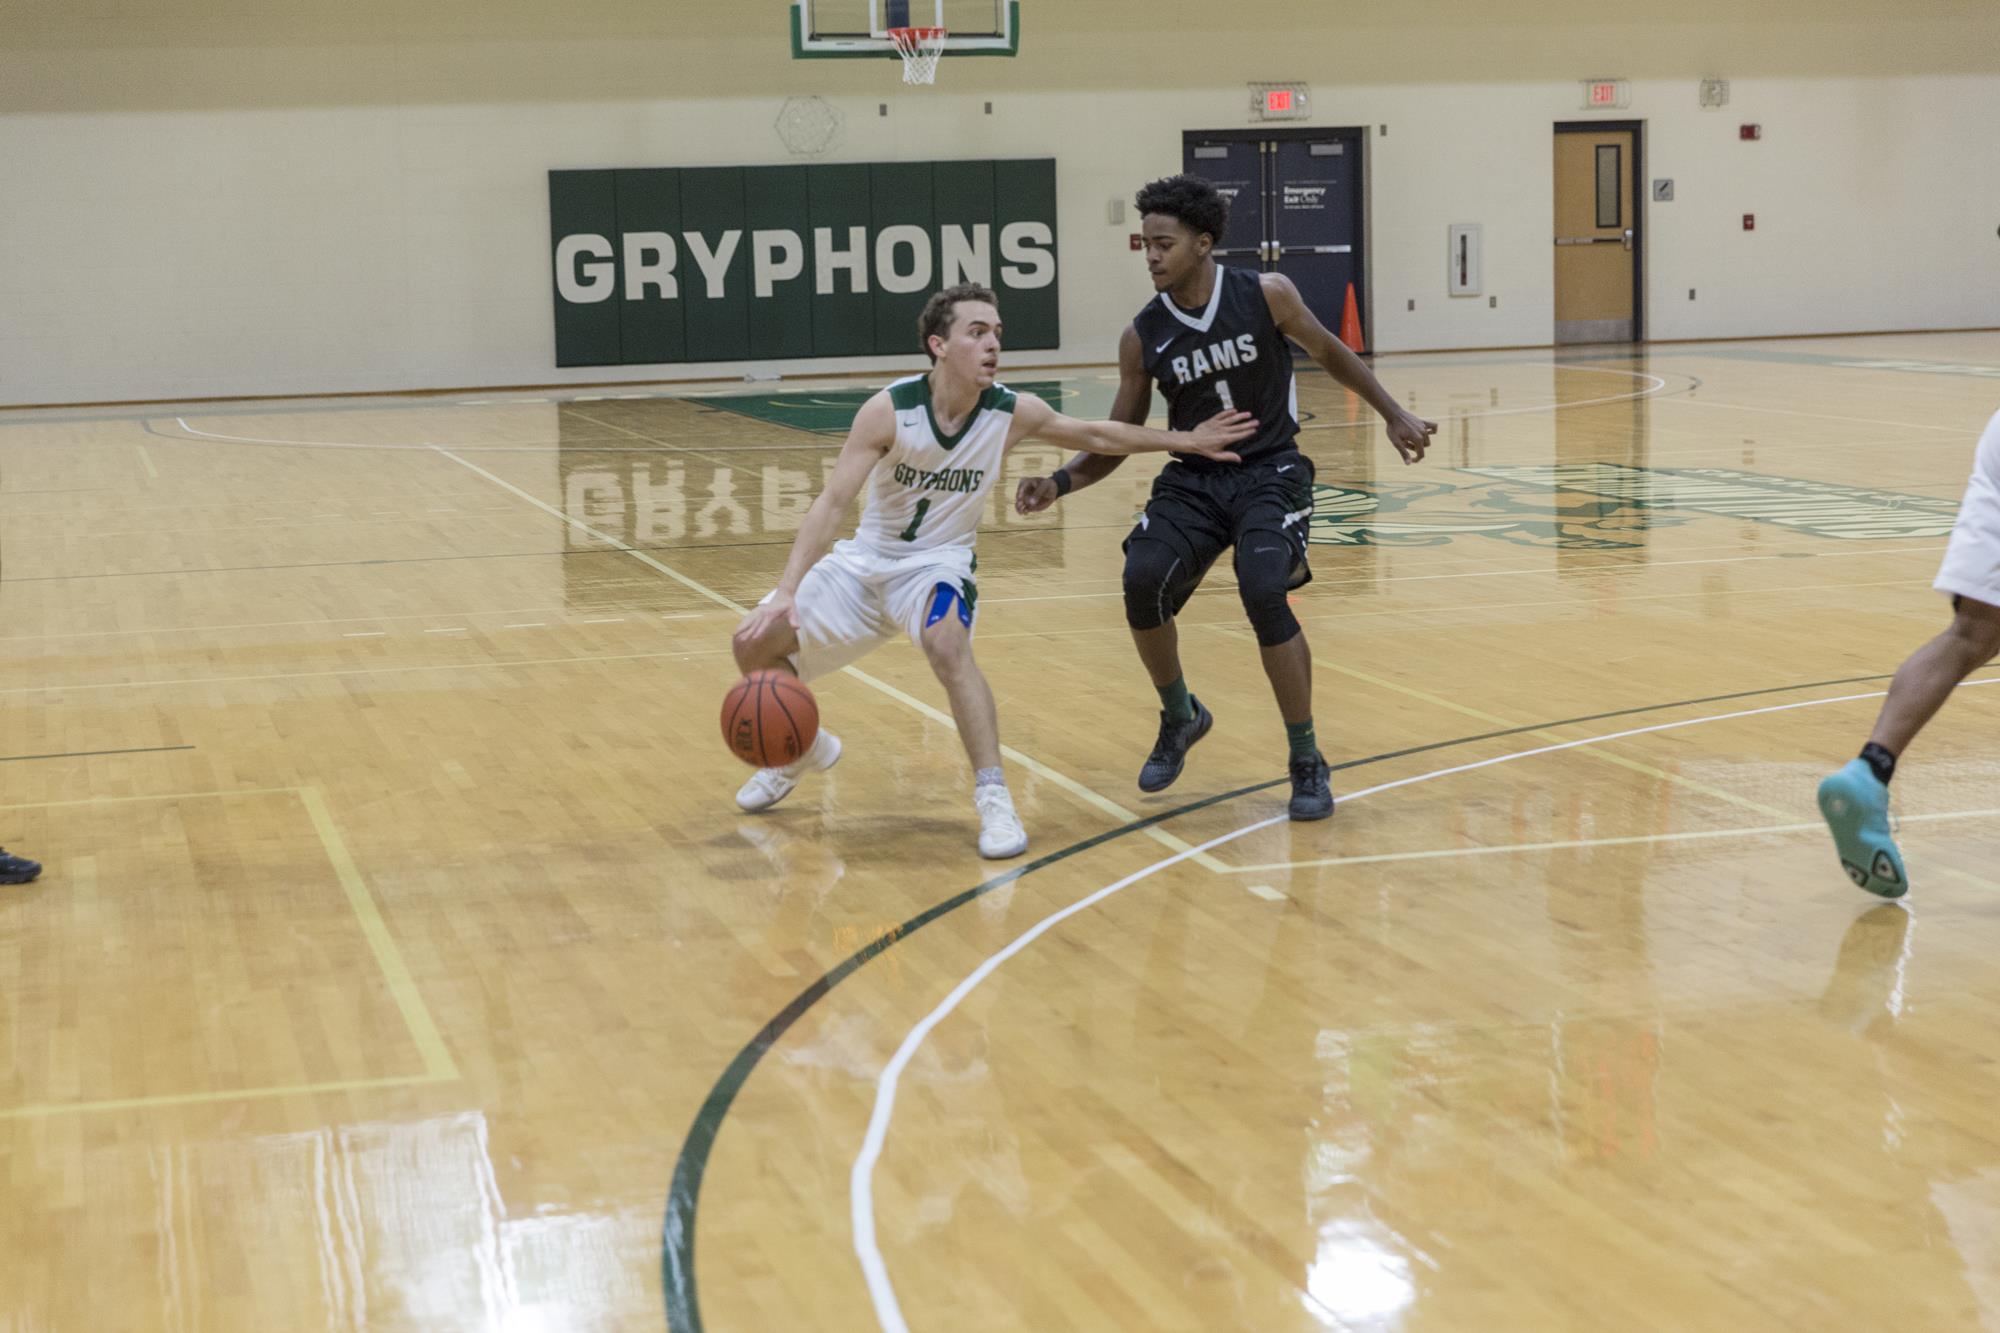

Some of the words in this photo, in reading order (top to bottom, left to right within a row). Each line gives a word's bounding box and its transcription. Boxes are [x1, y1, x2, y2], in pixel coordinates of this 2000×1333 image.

[1269, 91, 1290, 110] EXIT
[1593, 84, 1614, 103] EXIT
[556, 221, 1055, 303] GRYPHONS
[1172, 333, 1258, 385] RAMS
[1215, 380, 1234, 410] 1
[895, 463, 984, 493] GRYPHONS
[901, 498, 931, 542] 1
